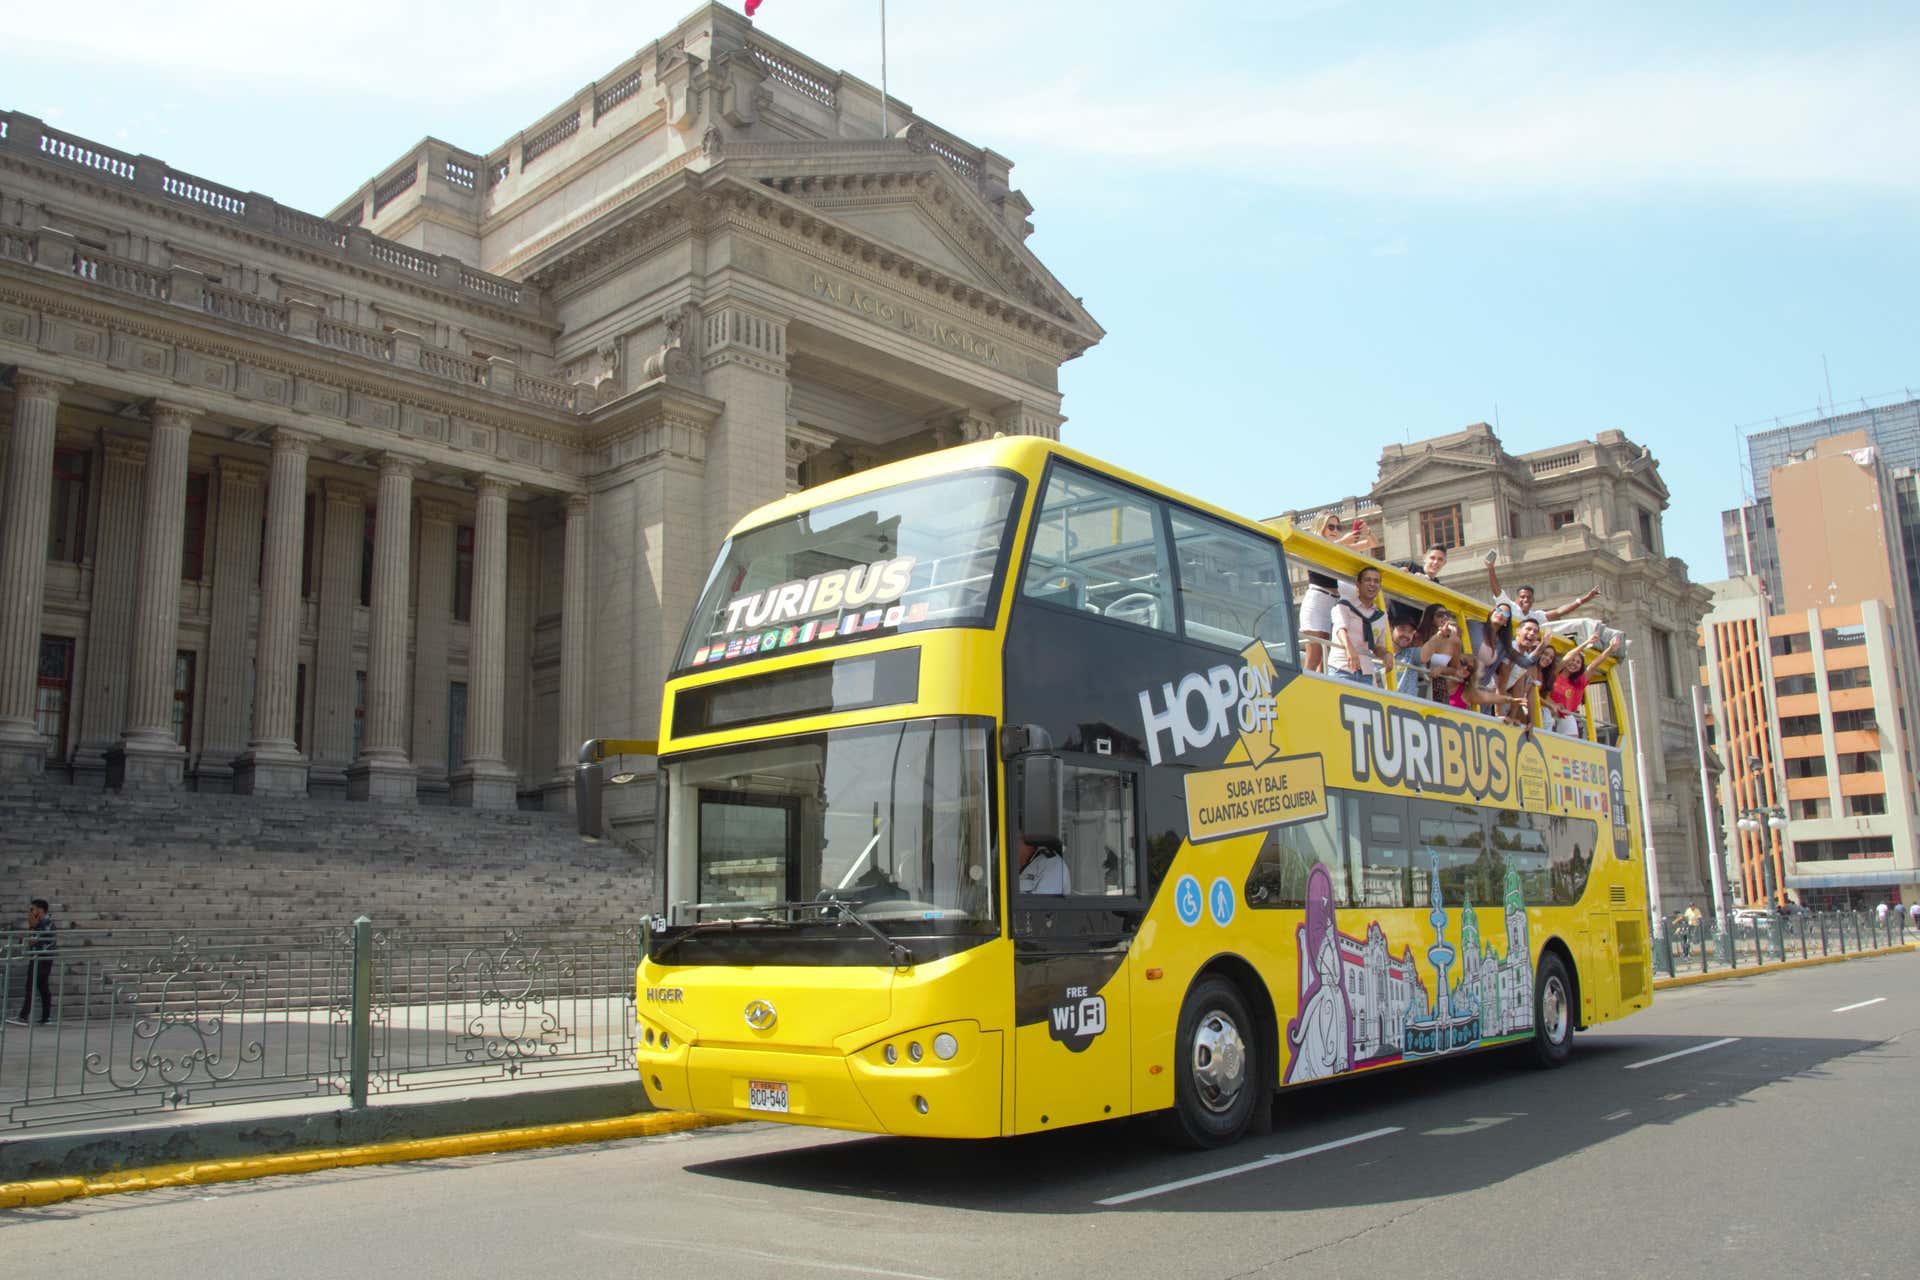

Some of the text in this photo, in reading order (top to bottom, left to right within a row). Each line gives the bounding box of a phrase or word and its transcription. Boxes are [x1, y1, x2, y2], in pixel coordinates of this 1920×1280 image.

[724, 556, 916, 634] TURIBUS
[1239, 663, 1272, 700] ON
[1138, 664, 1240, 767] HOP
[1238, 696, 1278, 733] OFF
[1342, 698, 1508, 799] TURIBUS
[1226, 775, 1288, 799] SUBA Y BAJE
[1199, 789, 1317, 825] CUANTAS VECES QUIERA
[646, 988, 684, 1002] HIGER
[1066, 986, 1088, 999] FREE
